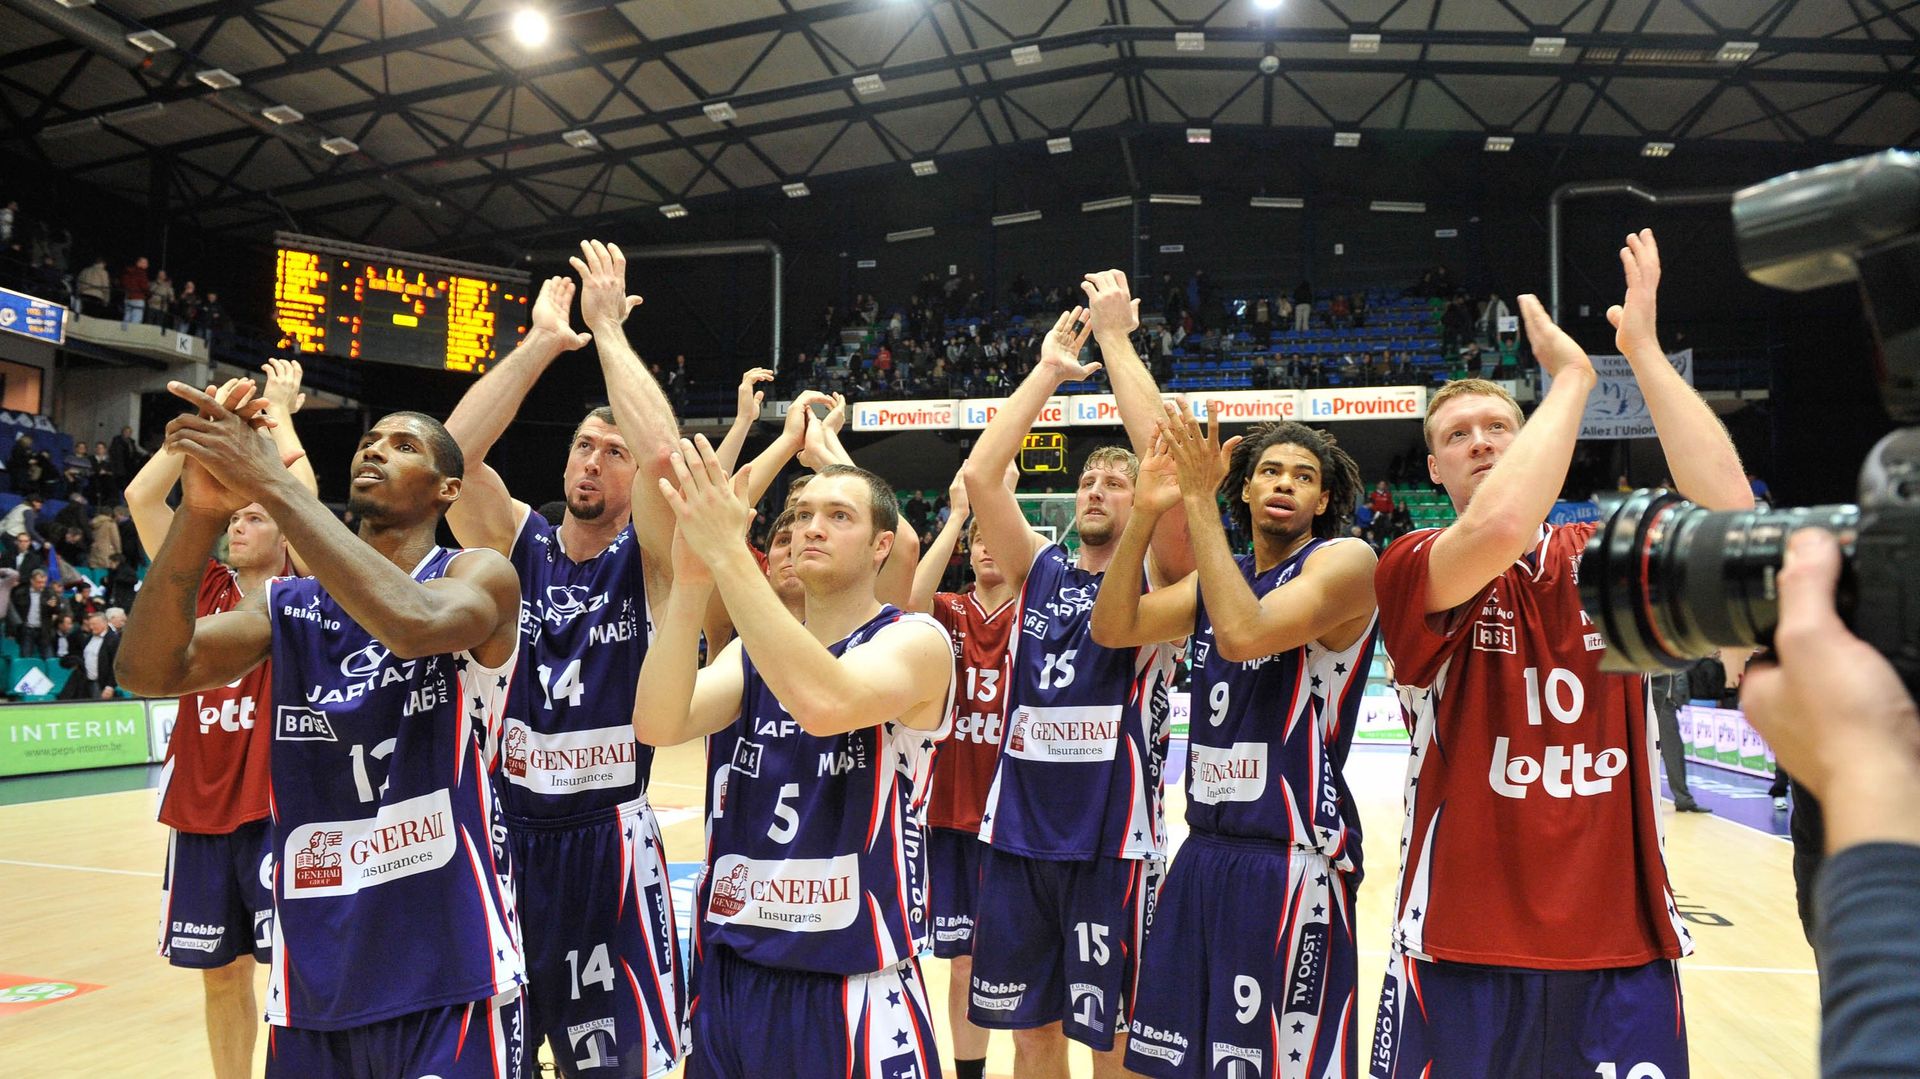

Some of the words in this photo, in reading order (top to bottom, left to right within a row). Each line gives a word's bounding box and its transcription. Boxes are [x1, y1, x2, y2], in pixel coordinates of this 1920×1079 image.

[179, 337, 188, 350] K
[861, 408, 951, 426] LaProvince
[1312, 396, 1416, 415] LaProvince
[1582, 426, 1611, 436] Allez
[284, 605, 341, 631] BRANTNO
[306, 659, 416, 704] JARTAZ
[1039, 650, 1078, 690] 15
[436, 679, 448, 704] PILS
[537, 659, 584, 710] 14
[965, 666, 1000, 703] 13
[1523, 667, 1585, 725] 10
[1209, 681, 1230, 727] 9
[10, 719, 135, 743] INTERIM
[286, 714, 329, 735] BASE
[1047, 745, 1103, 755] Insurances
[552, 773, 614, 787] Insurances
[767, 783, 800, 845] 5
[297, 869, 341, 880] GENERALI
[183, 922, 225, 936] Robbe
[1073, 922, 1110, 966] 15
[1298, 932, 1316, 978] OOST
[565, 943, 615, 1000] 14
[981, 980, 1027, 994] Robbe
[1234, 975, 1261, 1024] 9
[1292, 982, 1309, 1005] TV
[1384, 987, 1395, 1015] TV
[1143, 1025, 1188, 1048] Robbe
[1378, 1016, 1392, 1073] OOST
